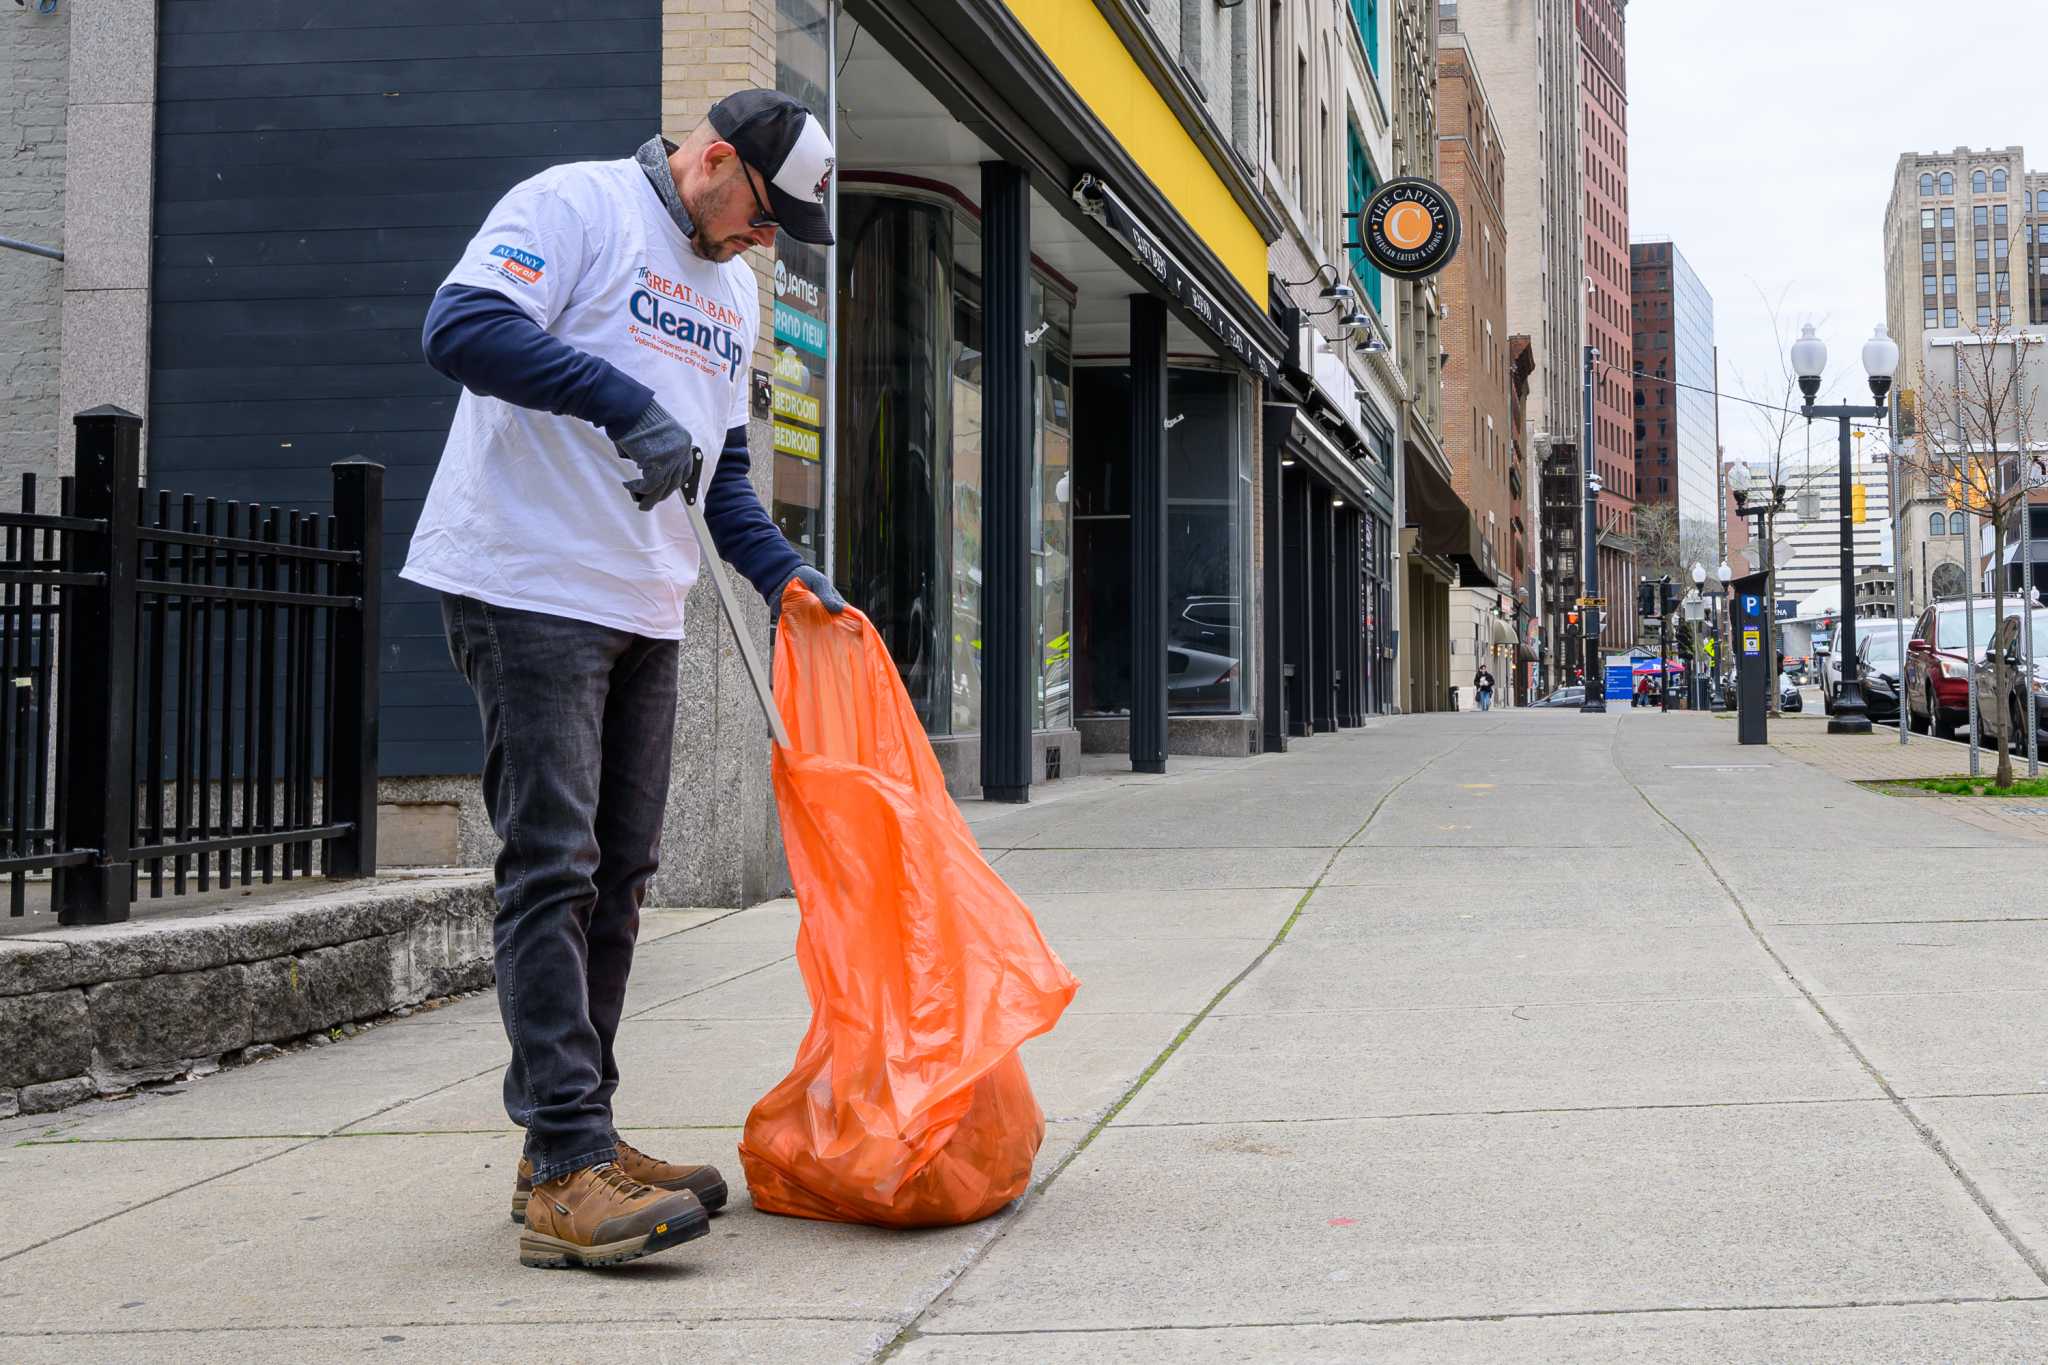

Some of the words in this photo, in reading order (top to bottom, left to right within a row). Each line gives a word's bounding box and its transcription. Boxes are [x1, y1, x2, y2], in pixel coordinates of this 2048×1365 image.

[1371, 196, 1393, 224] THE
[1393, 188, 1445, 223] CAPITAL
[1391, 208, 1421, 243] C
[497, 246, 539, 268] ALBANY
[1373, 232, 1395, 258] AMERICAN
[646, 271, 692, 302] GREAT
[786, 274, 818, 307] JAMES
[802, 324, 823, 349] NEW
[774, 391, 817, 420] BEDROOM
[774, 424, 817, 454] BEDROOM
[1747, 597, 1757, 613] P
